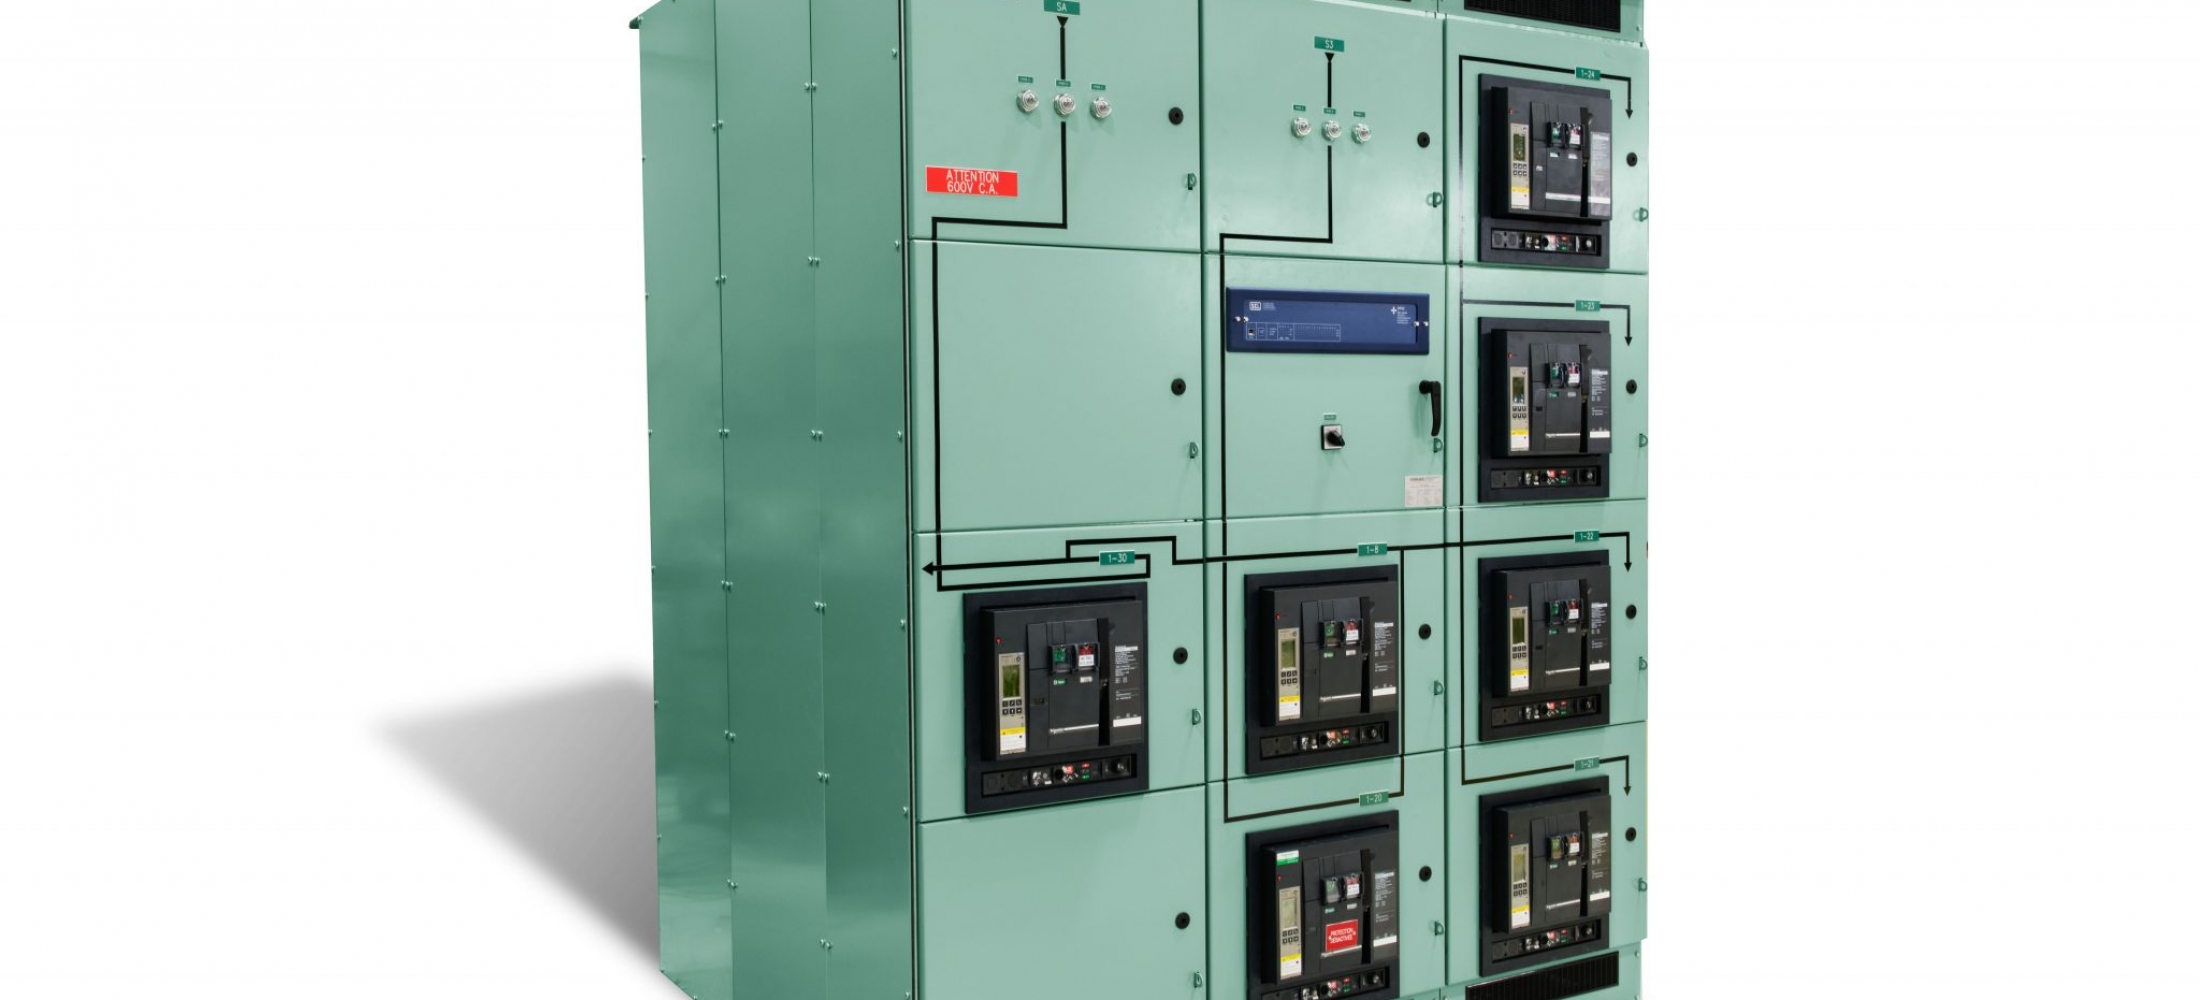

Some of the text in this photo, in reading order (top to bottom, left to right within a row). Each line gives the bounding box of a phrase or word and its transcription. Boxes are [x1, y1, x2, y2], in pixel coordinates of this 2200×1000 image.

[1056, 1, 1067, 12] SA
[1325, 39, 1334, 49] S3
[946, 169, 999, 184] ATTENTION
[947, 180, 998, 195] 600V C.A.
[1108, 553, 1128, 563] 1-30
